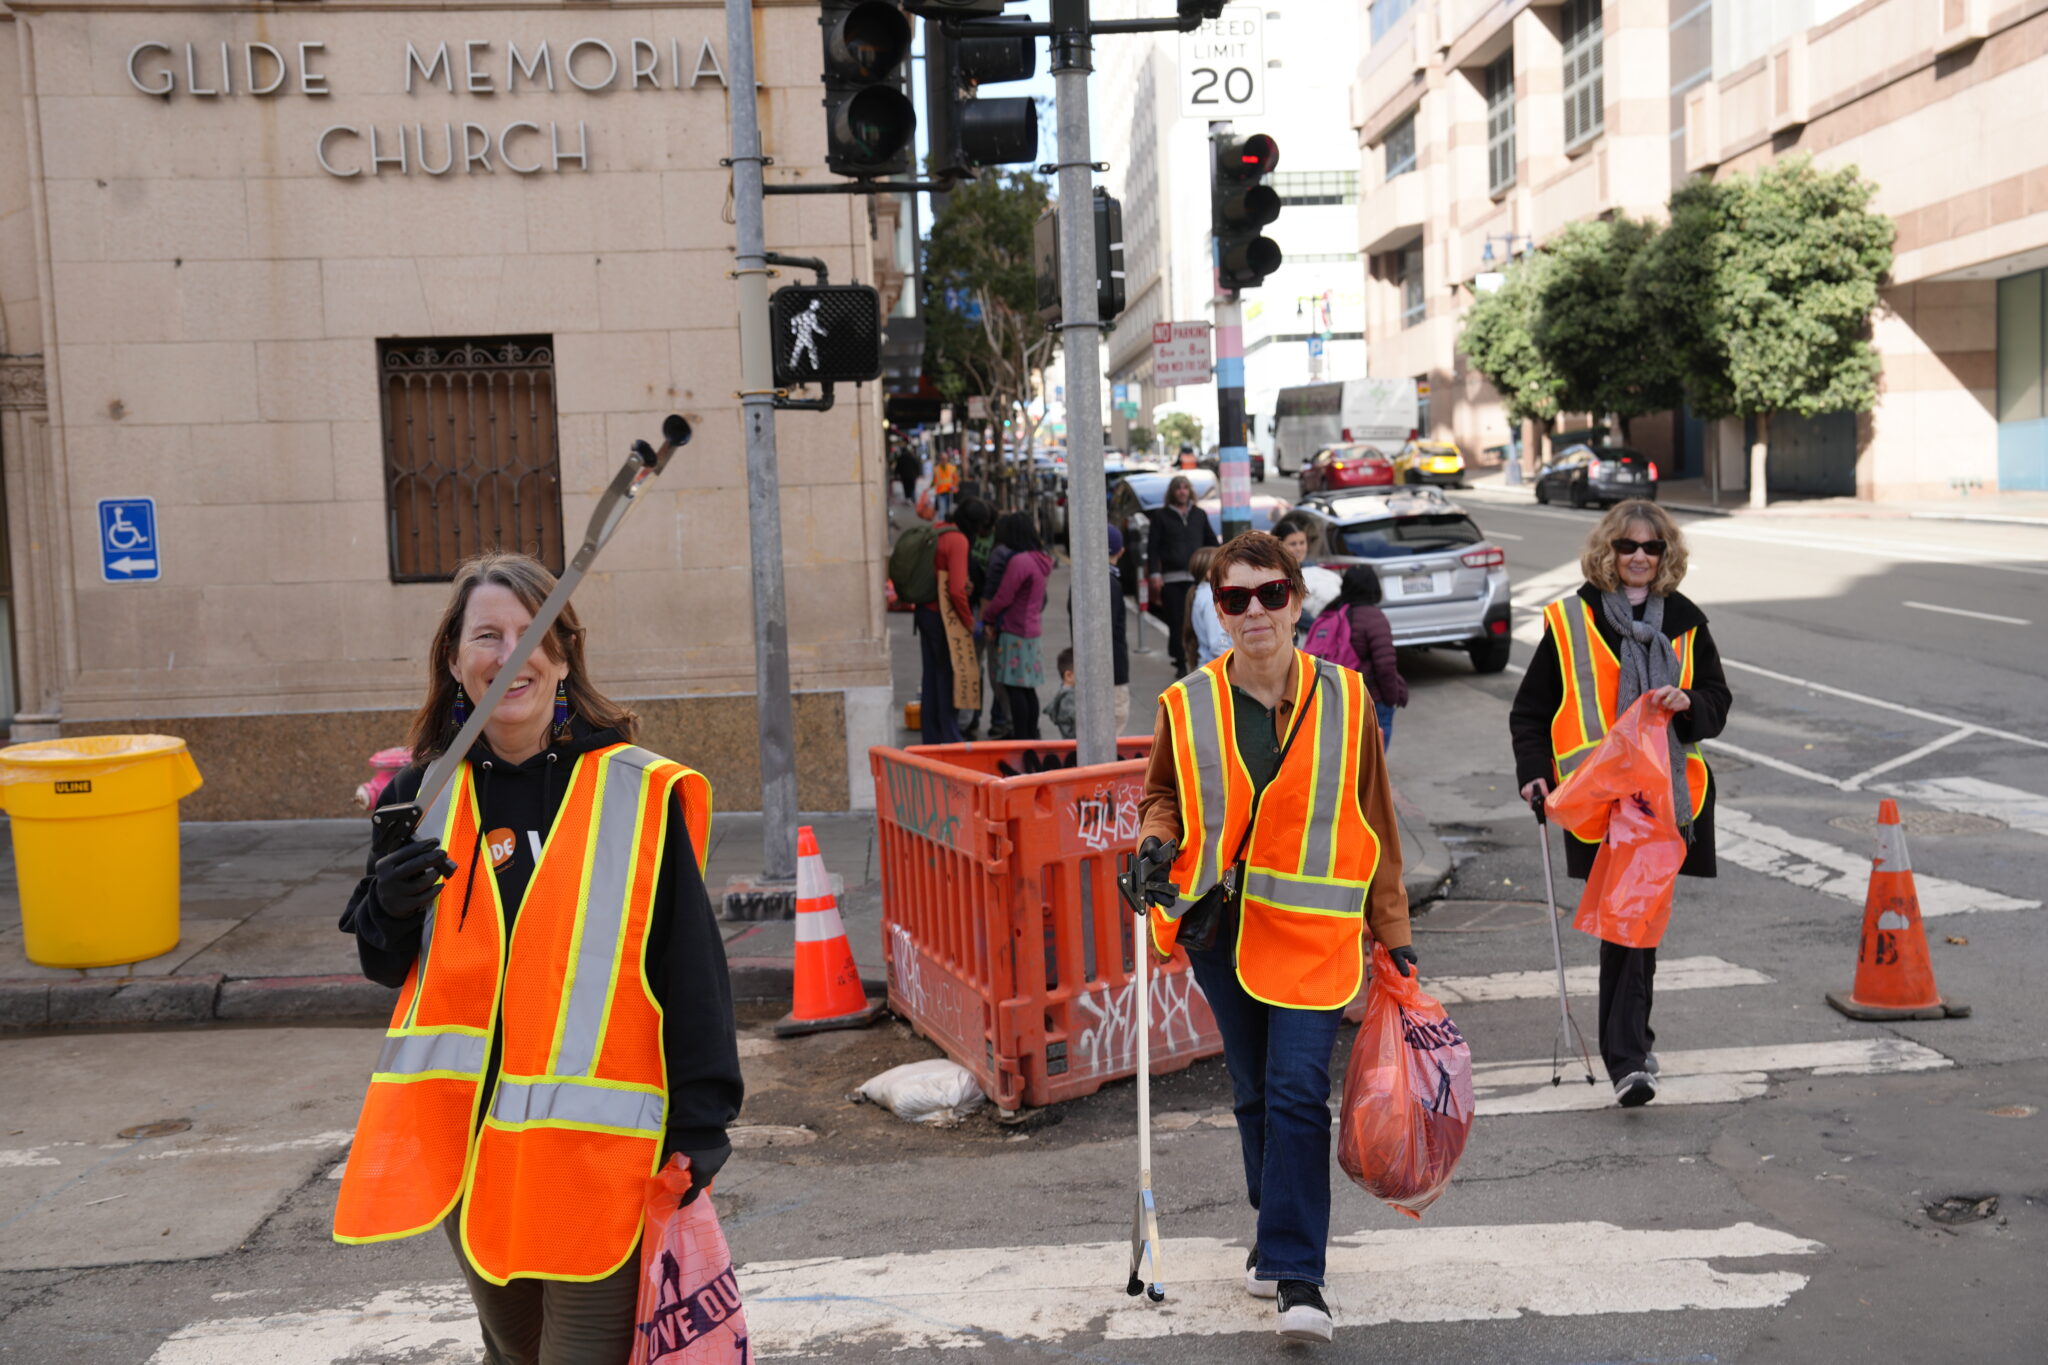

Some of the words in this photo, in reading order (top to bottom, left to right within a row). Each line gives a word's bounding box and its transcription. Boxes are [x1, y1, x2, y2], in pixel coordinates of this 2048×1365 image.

[1187, 20, 1255, 36] PEED
[1194, 43, 1246, 60] LIMIT
[127, 40, 330, 96] GLIDE
[405, 36, 763, 93] MEMORIA
[1191, 66, 1254, 104] 20
[316, 119, 588, 177] CHURCH
[1154, 325, 1169, 341] NO
[1173, 327, 1208, 339] PARKING
[56, 782, 90, 792] ULINE
[488, 837, 514, 864] IDE
[649, 1306, 700, 1361] OVE
[697, 1272, 742, 1323] OU
